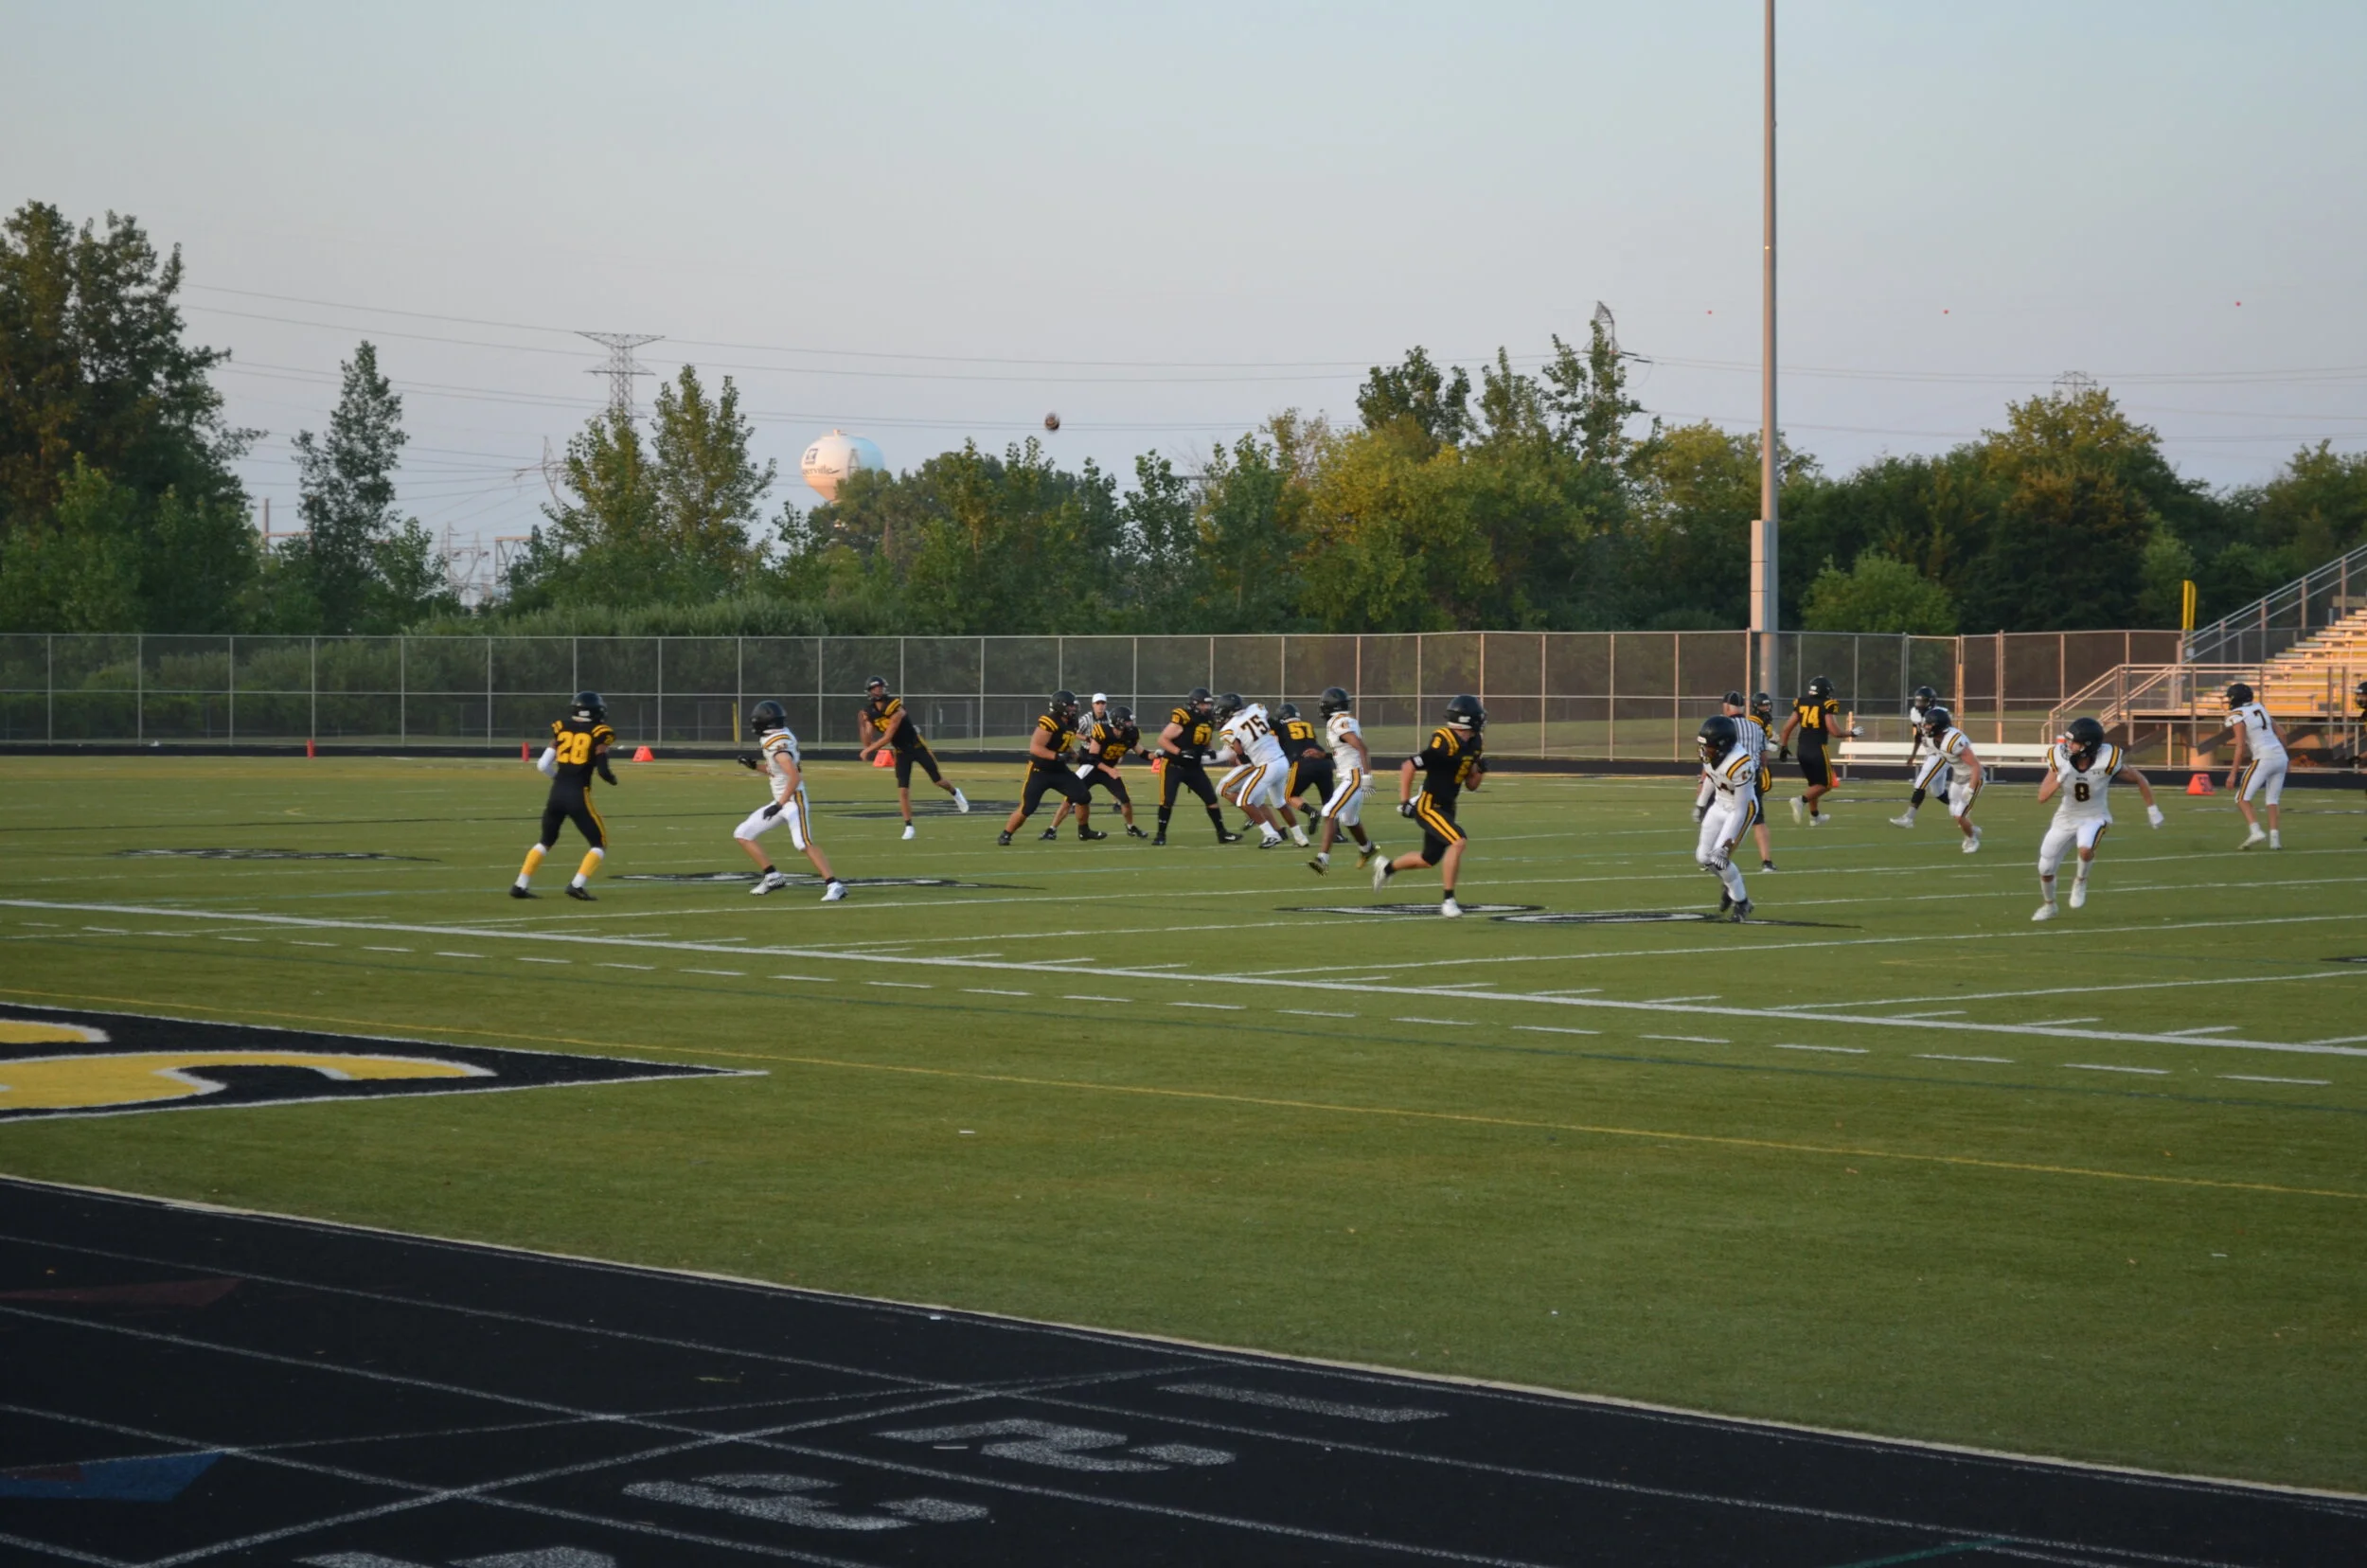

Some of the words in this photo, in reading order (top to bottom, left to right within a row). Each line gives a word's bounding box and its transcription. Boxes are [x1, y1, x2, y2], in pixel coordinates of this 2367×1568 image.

[1240, 714, 1268, 742] 75
[1799, 705, 1820, 729] 74
[2252, 709, 2268, 730] 7
[1287, 722, 1315, 739] 57
[556, 731, 592, 764] 28
[2074, 782, 2091, 802] 8
[869, 1418, 1235, 1472] 2
